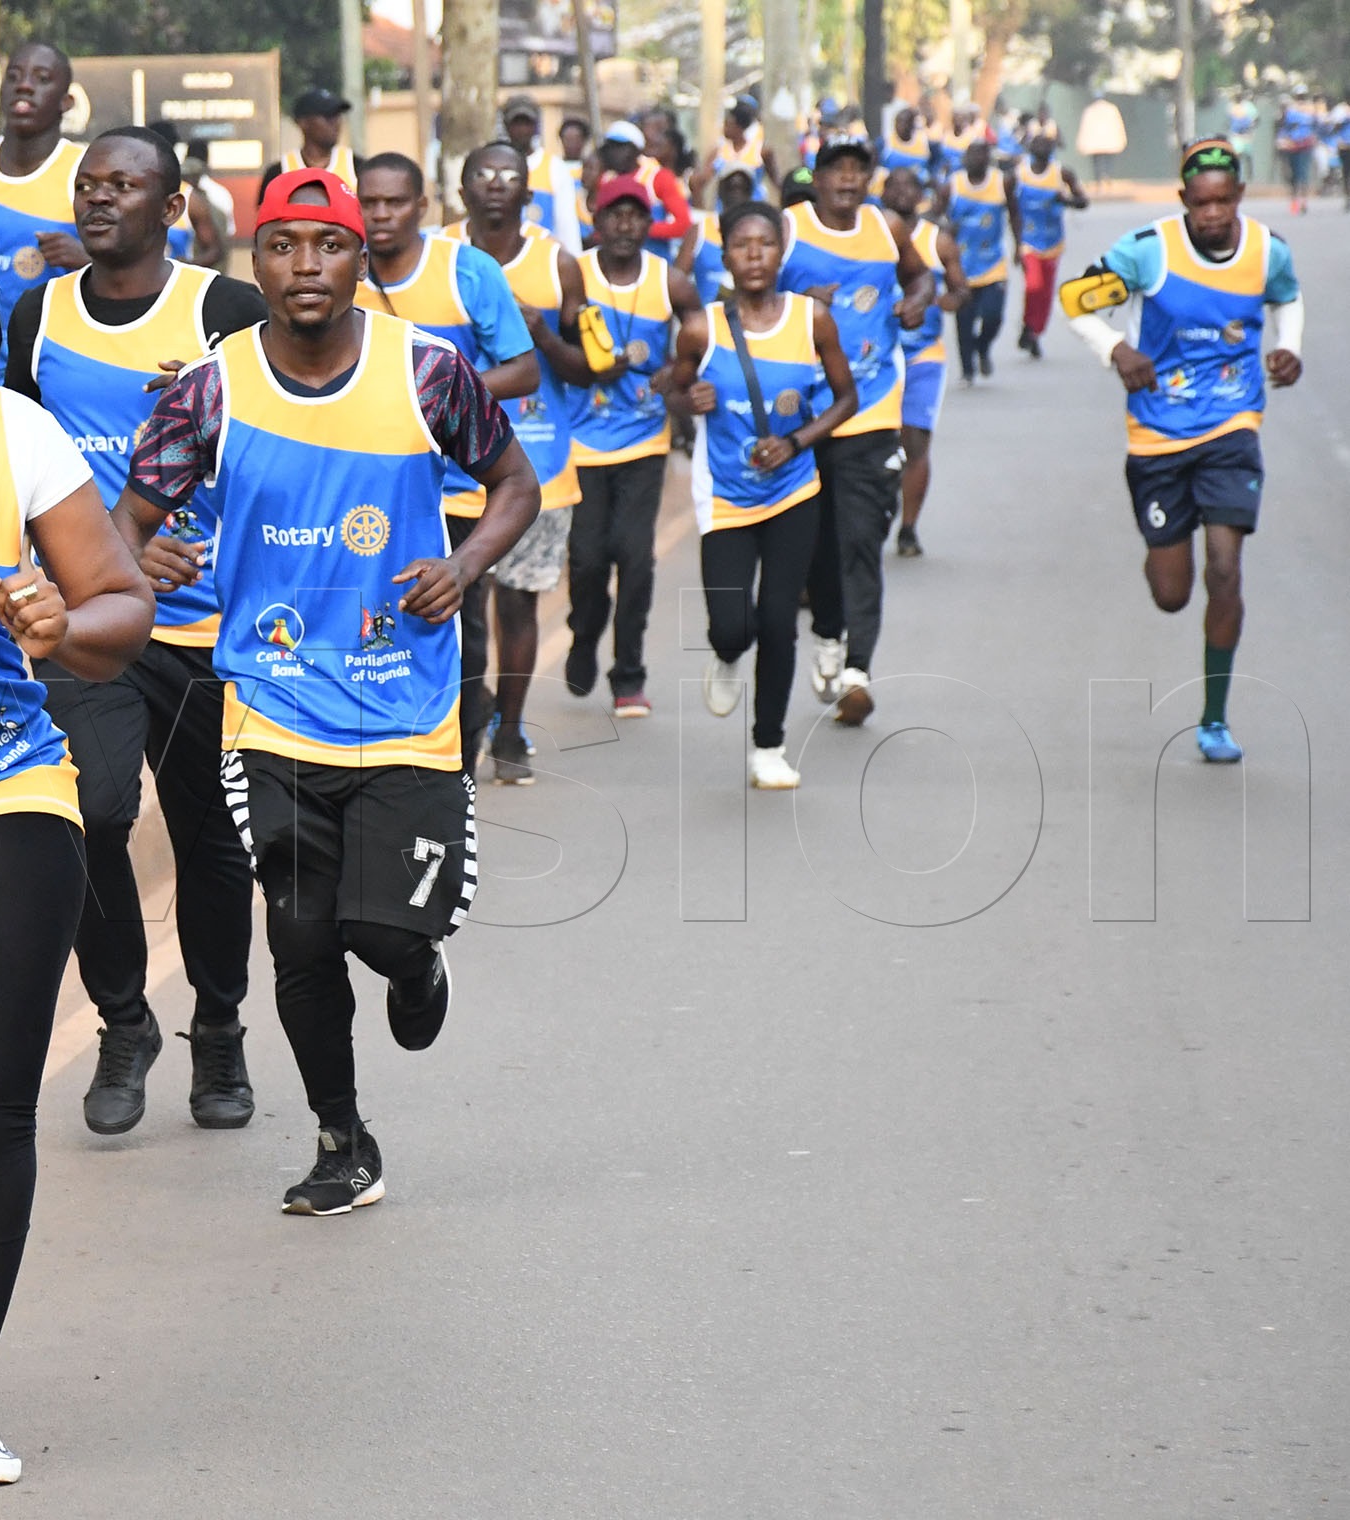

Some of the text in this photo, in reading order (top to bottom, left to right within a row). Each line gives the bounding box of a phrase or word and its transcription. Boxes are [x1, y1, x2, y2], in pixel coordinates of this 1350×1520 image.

[74, 434, 129, 455] otary
[1147, 501, 1167, 529] 6
[262, 524, 335, 547] Rotary
[345, 648, 412, 668] Parliament
[271, 663, 306, 678] Bank
[351, 664, 410, 685] of Uganda
[408, 836, 446, 908] 7
